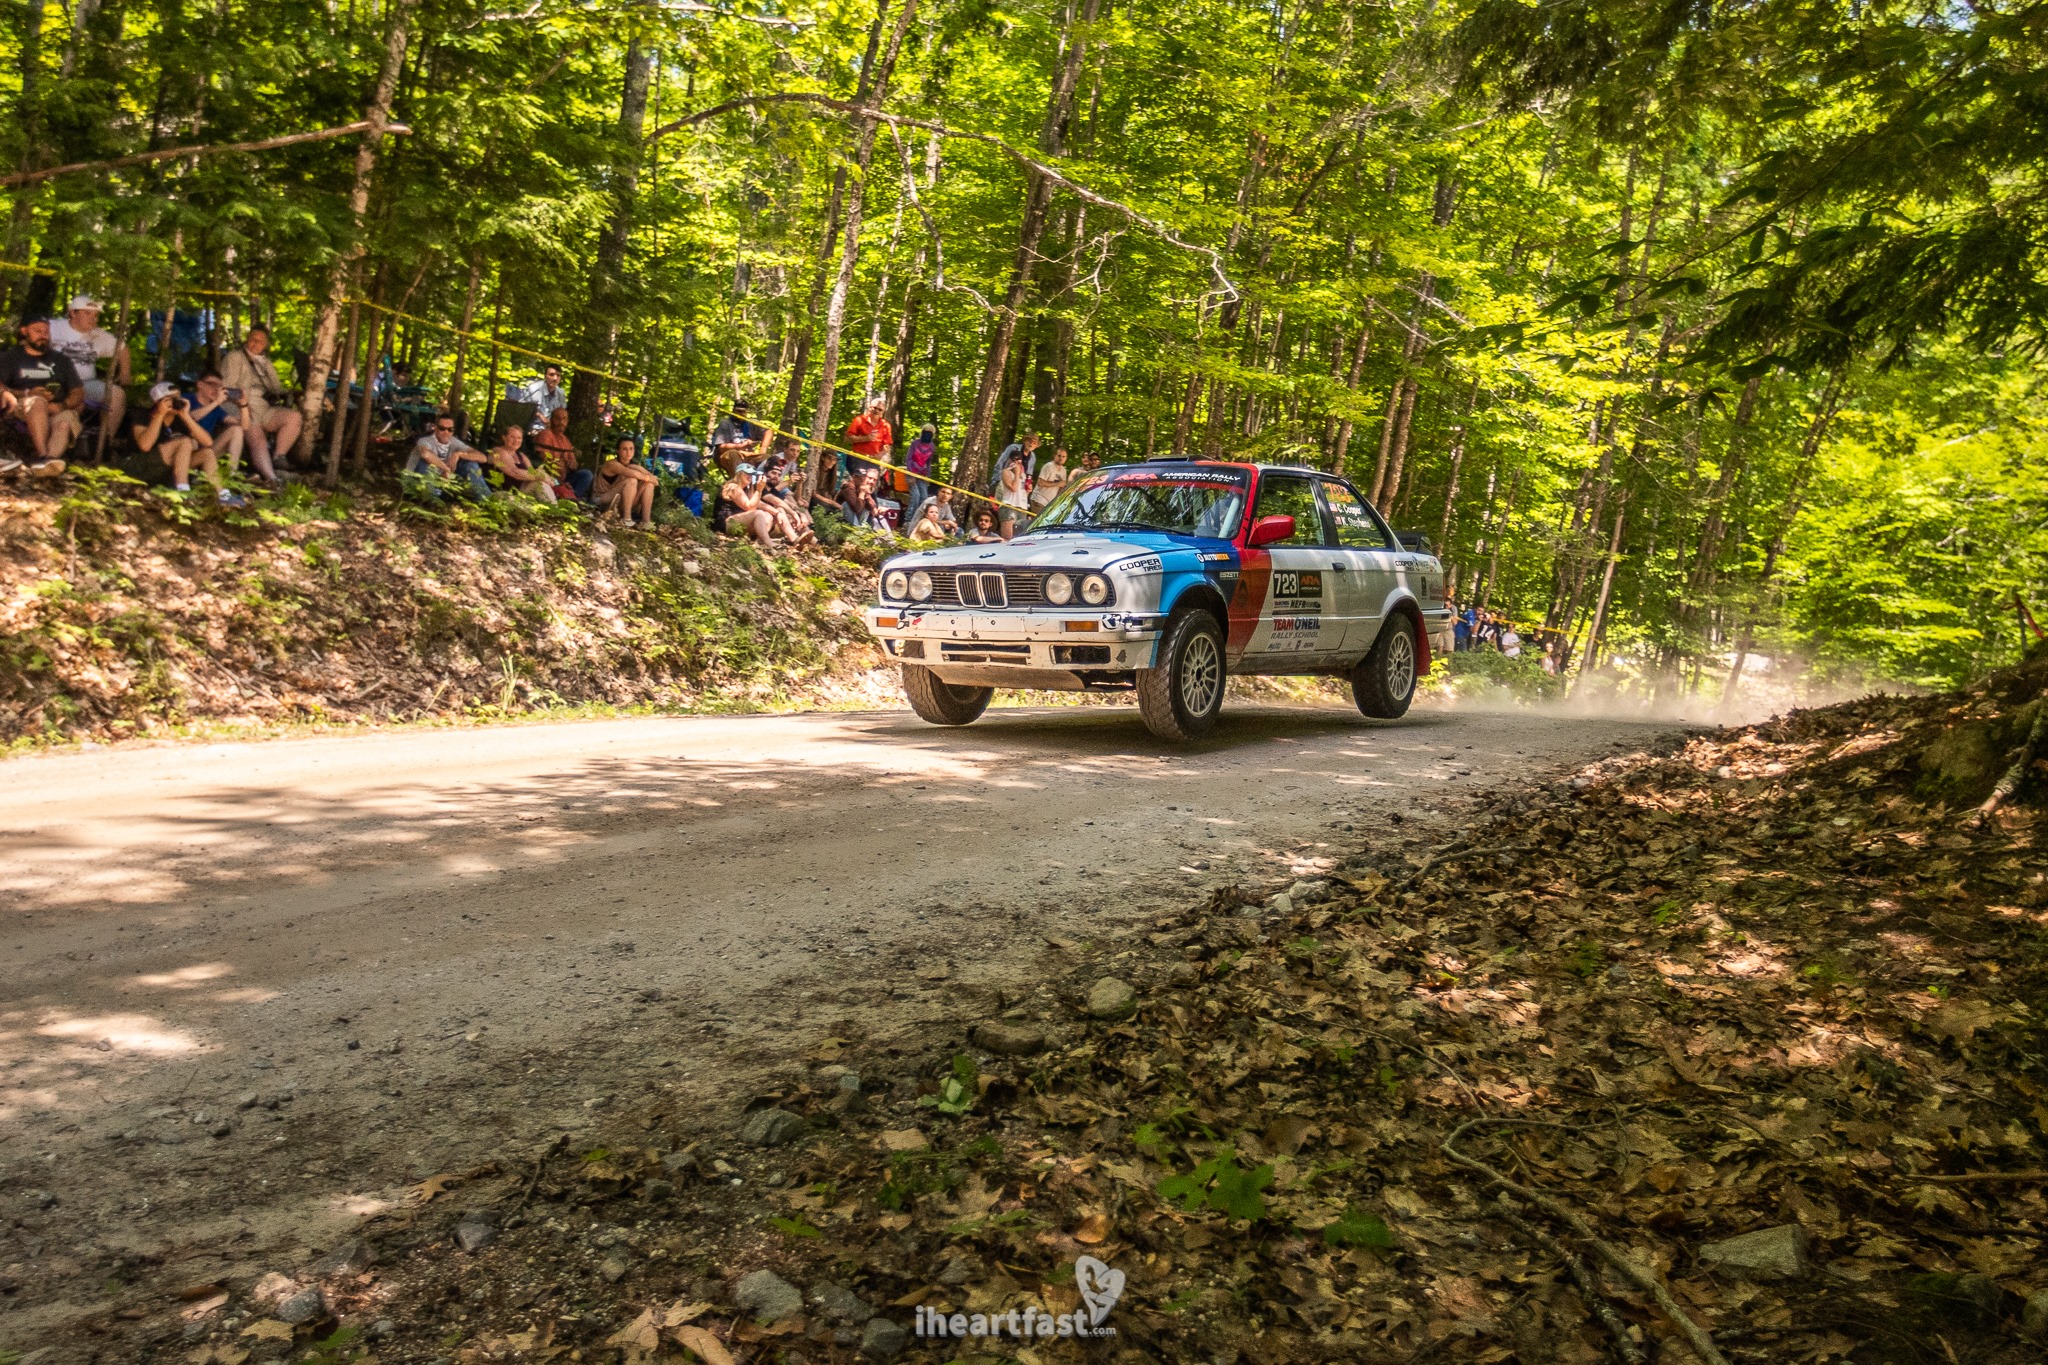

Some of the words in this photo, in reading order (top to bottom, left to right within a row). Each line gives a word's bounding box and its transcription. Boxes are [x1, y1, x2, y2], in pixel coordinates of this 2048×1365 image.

[1211, 473, 1241, 481] RALLY
[1119, 558, 1161, 572] COOPER
[1142, 564, 1163, 572] TIRES
[1273, 573, 1297, 595] 723
[1273, 618, 1294, 631] TEAM
[1293, 631, 1319, 639] SCHOOL
